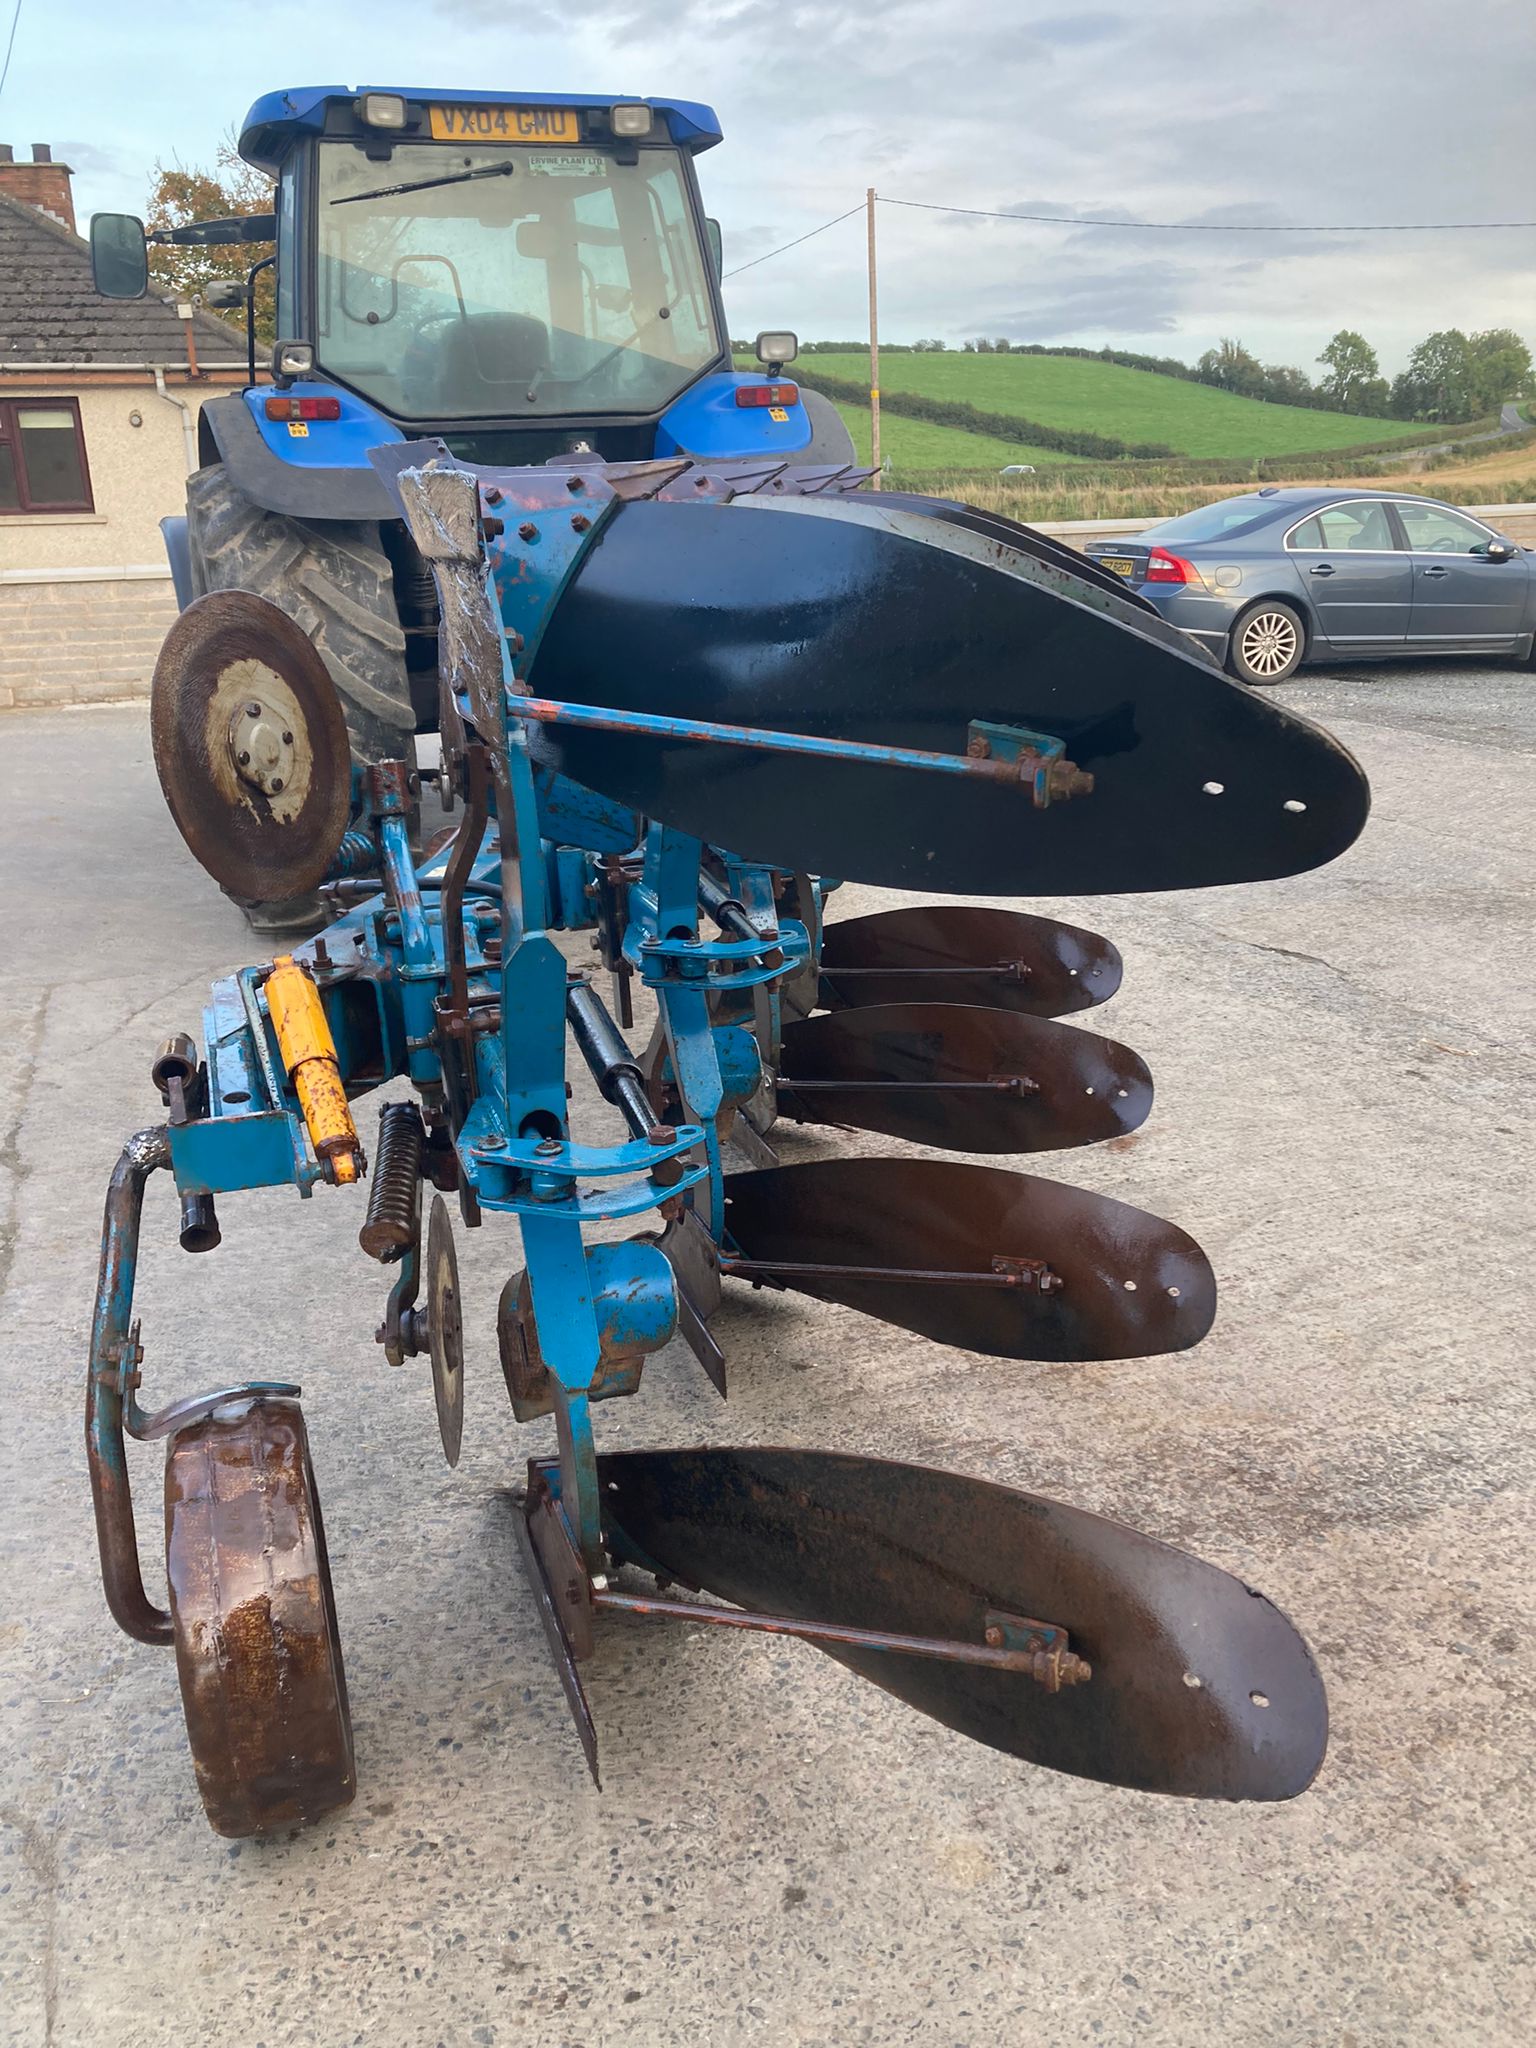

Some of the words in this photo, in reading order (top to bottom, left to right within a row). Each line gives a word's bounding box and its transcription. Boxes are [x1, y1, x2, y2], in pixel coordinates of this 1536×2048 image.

[441, 107, 509, 134] VX04
[516, 109, 566, 136] GMU
[530, 157, 559, 165] ERVINE
[560, 157, 586, 165] PLANT
